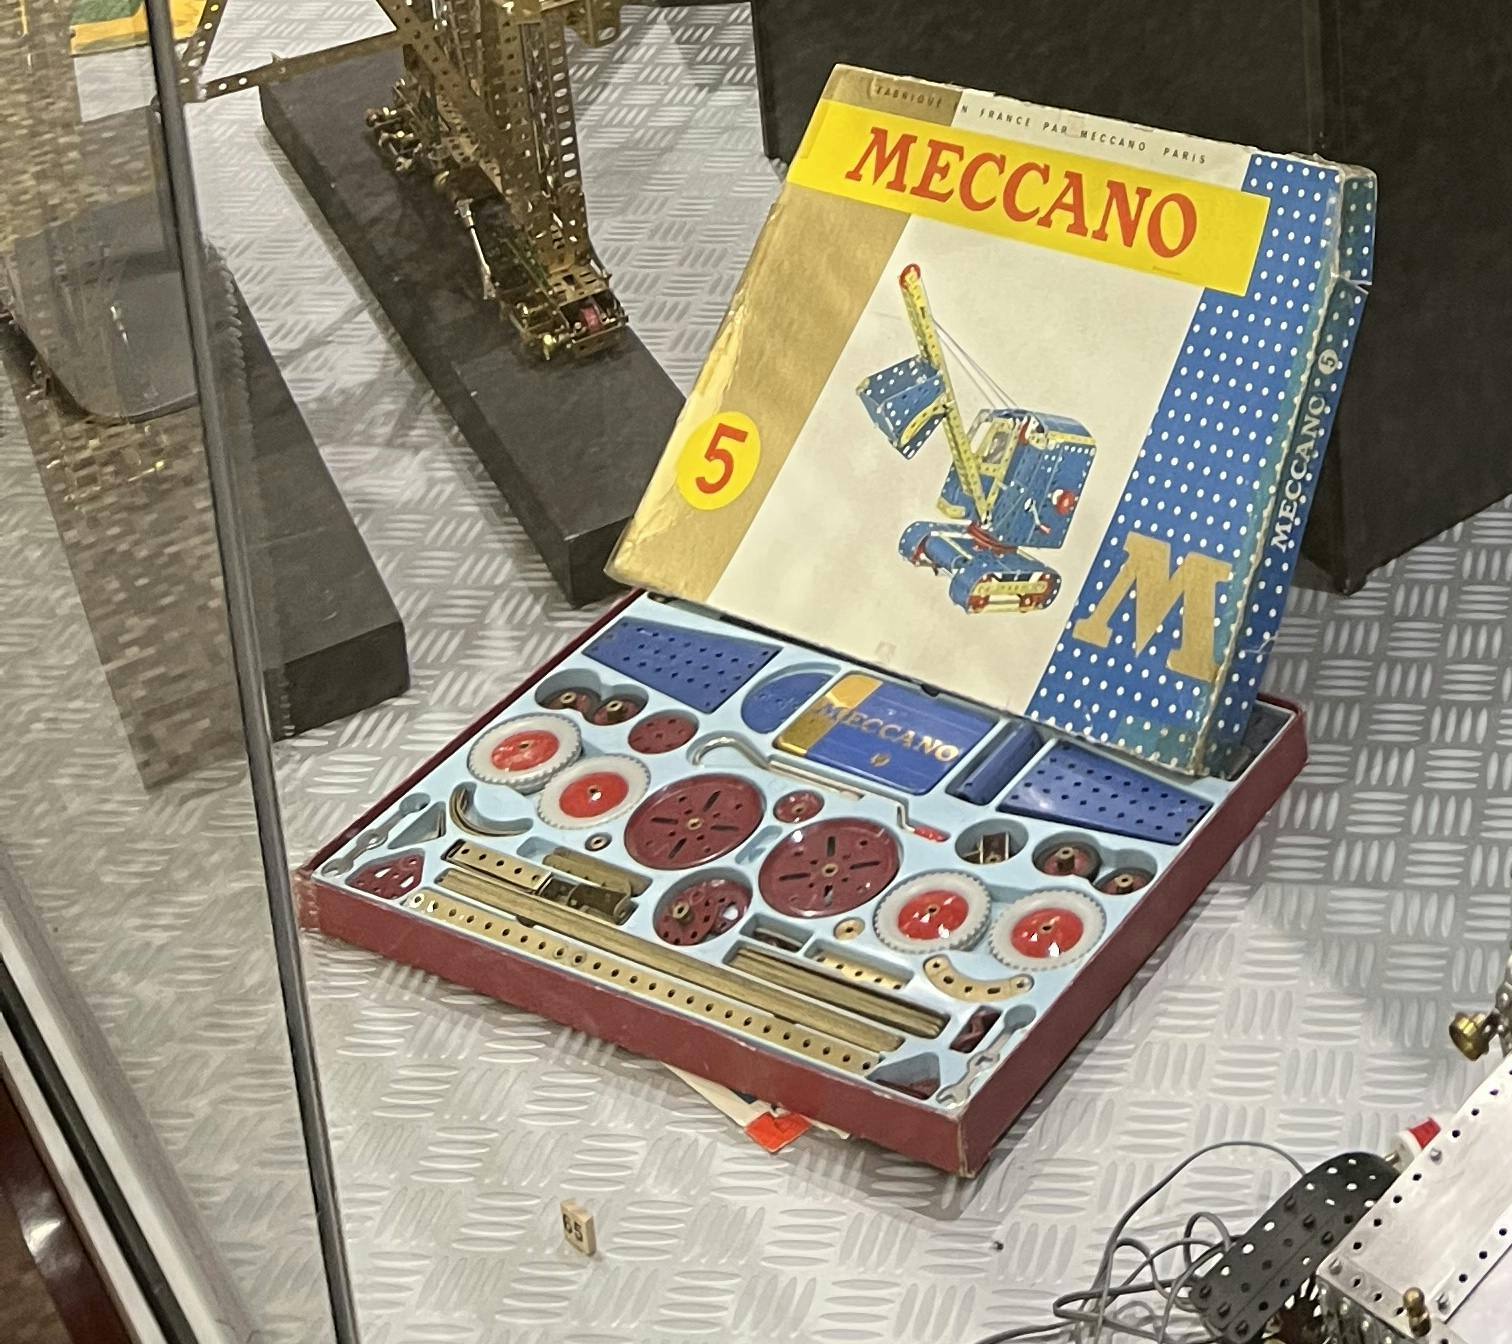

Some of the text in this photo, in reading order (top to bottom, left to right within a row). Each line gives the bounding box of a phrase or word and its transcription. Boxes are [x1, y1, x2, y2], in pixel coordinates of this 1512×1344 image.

[979, 108, 1031, 128] FRANCE
[1043, 121, 1068, 135] PAR
[1079, 129, 1147, 152] MECCANO
[1163, 147, 1206, 165] PARIS
[845, 126, 1198, 259] MECCANO
[1320, 353, 1336, 369] 5
[695, 420, 750, 495] 5
[1270, 396, 1326, 553] MECCANO
[1072, 531, 1231, 683] M
[818, 704, 961, 763] MECCANO
